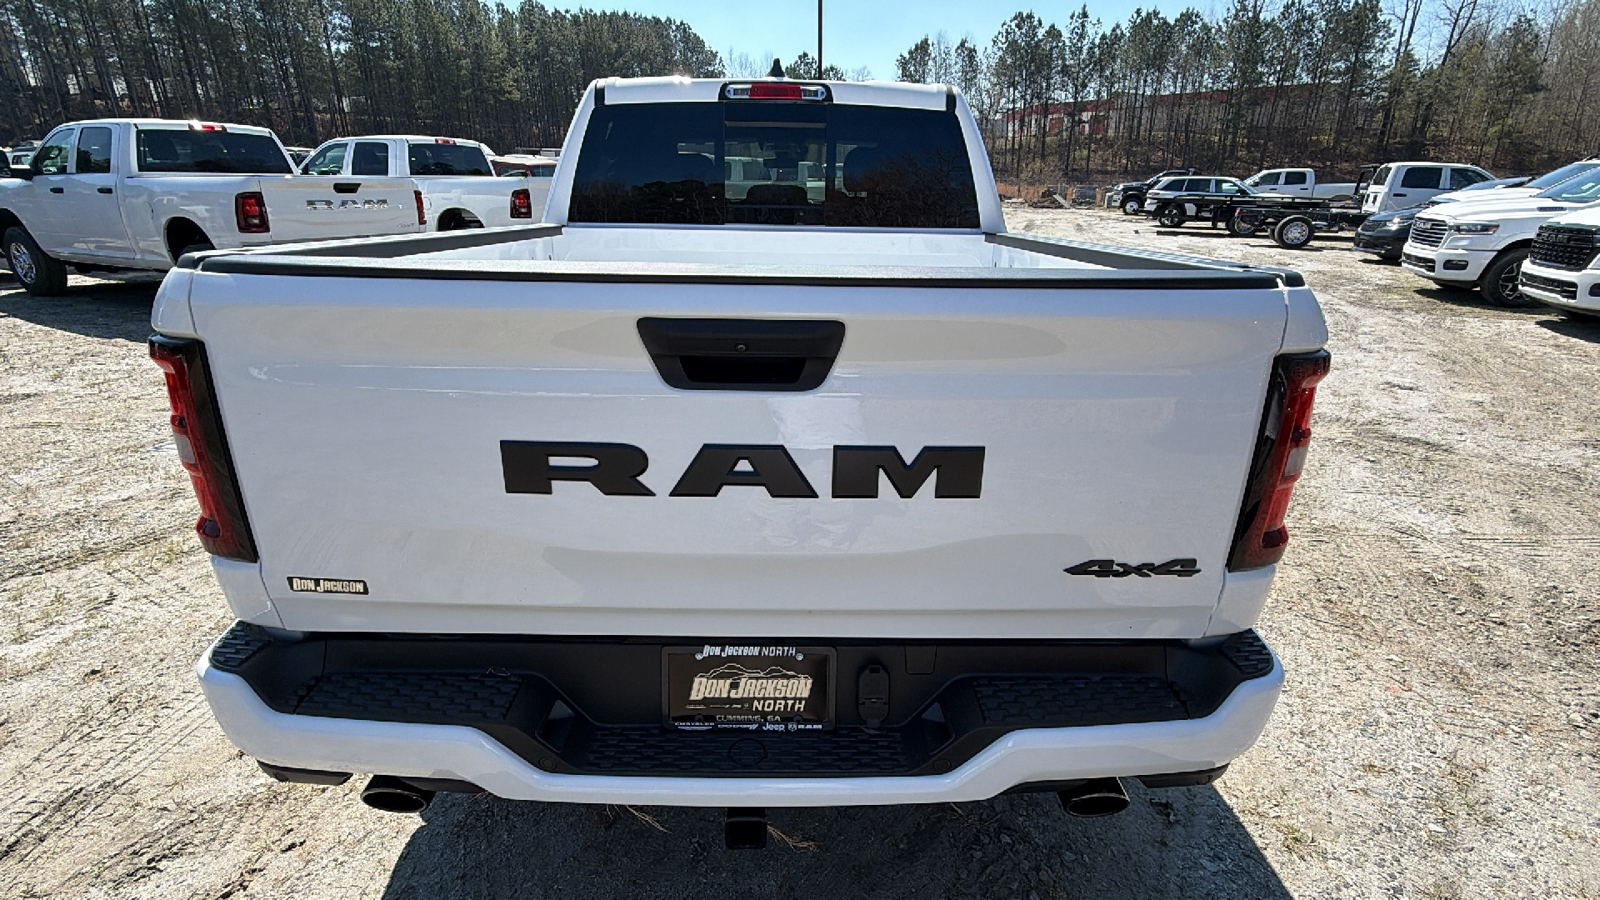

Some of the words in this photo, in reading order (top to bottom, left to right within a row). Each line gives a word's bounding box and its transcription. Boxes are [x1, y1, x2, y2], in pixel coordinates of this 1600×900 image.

[306, 199, 388, 211] RAM
[500, 440, 985, 498] RAM
[1063, 558, 1202, 578] 4x4
[292, 577, 316, 591] DON
[316, 579, 364, 593] JACKSON
[703, 645, 721, 657] DON
[721, 645, 760, 657] JACKSON
[761, 646, 796, 656] NORTH
[689, 677, 731, 700] DON
[730, 677, 813, 699] JACKSON
[752, 700, 806, 712] NORTH
[762, 722, 785, 731] Jeep
